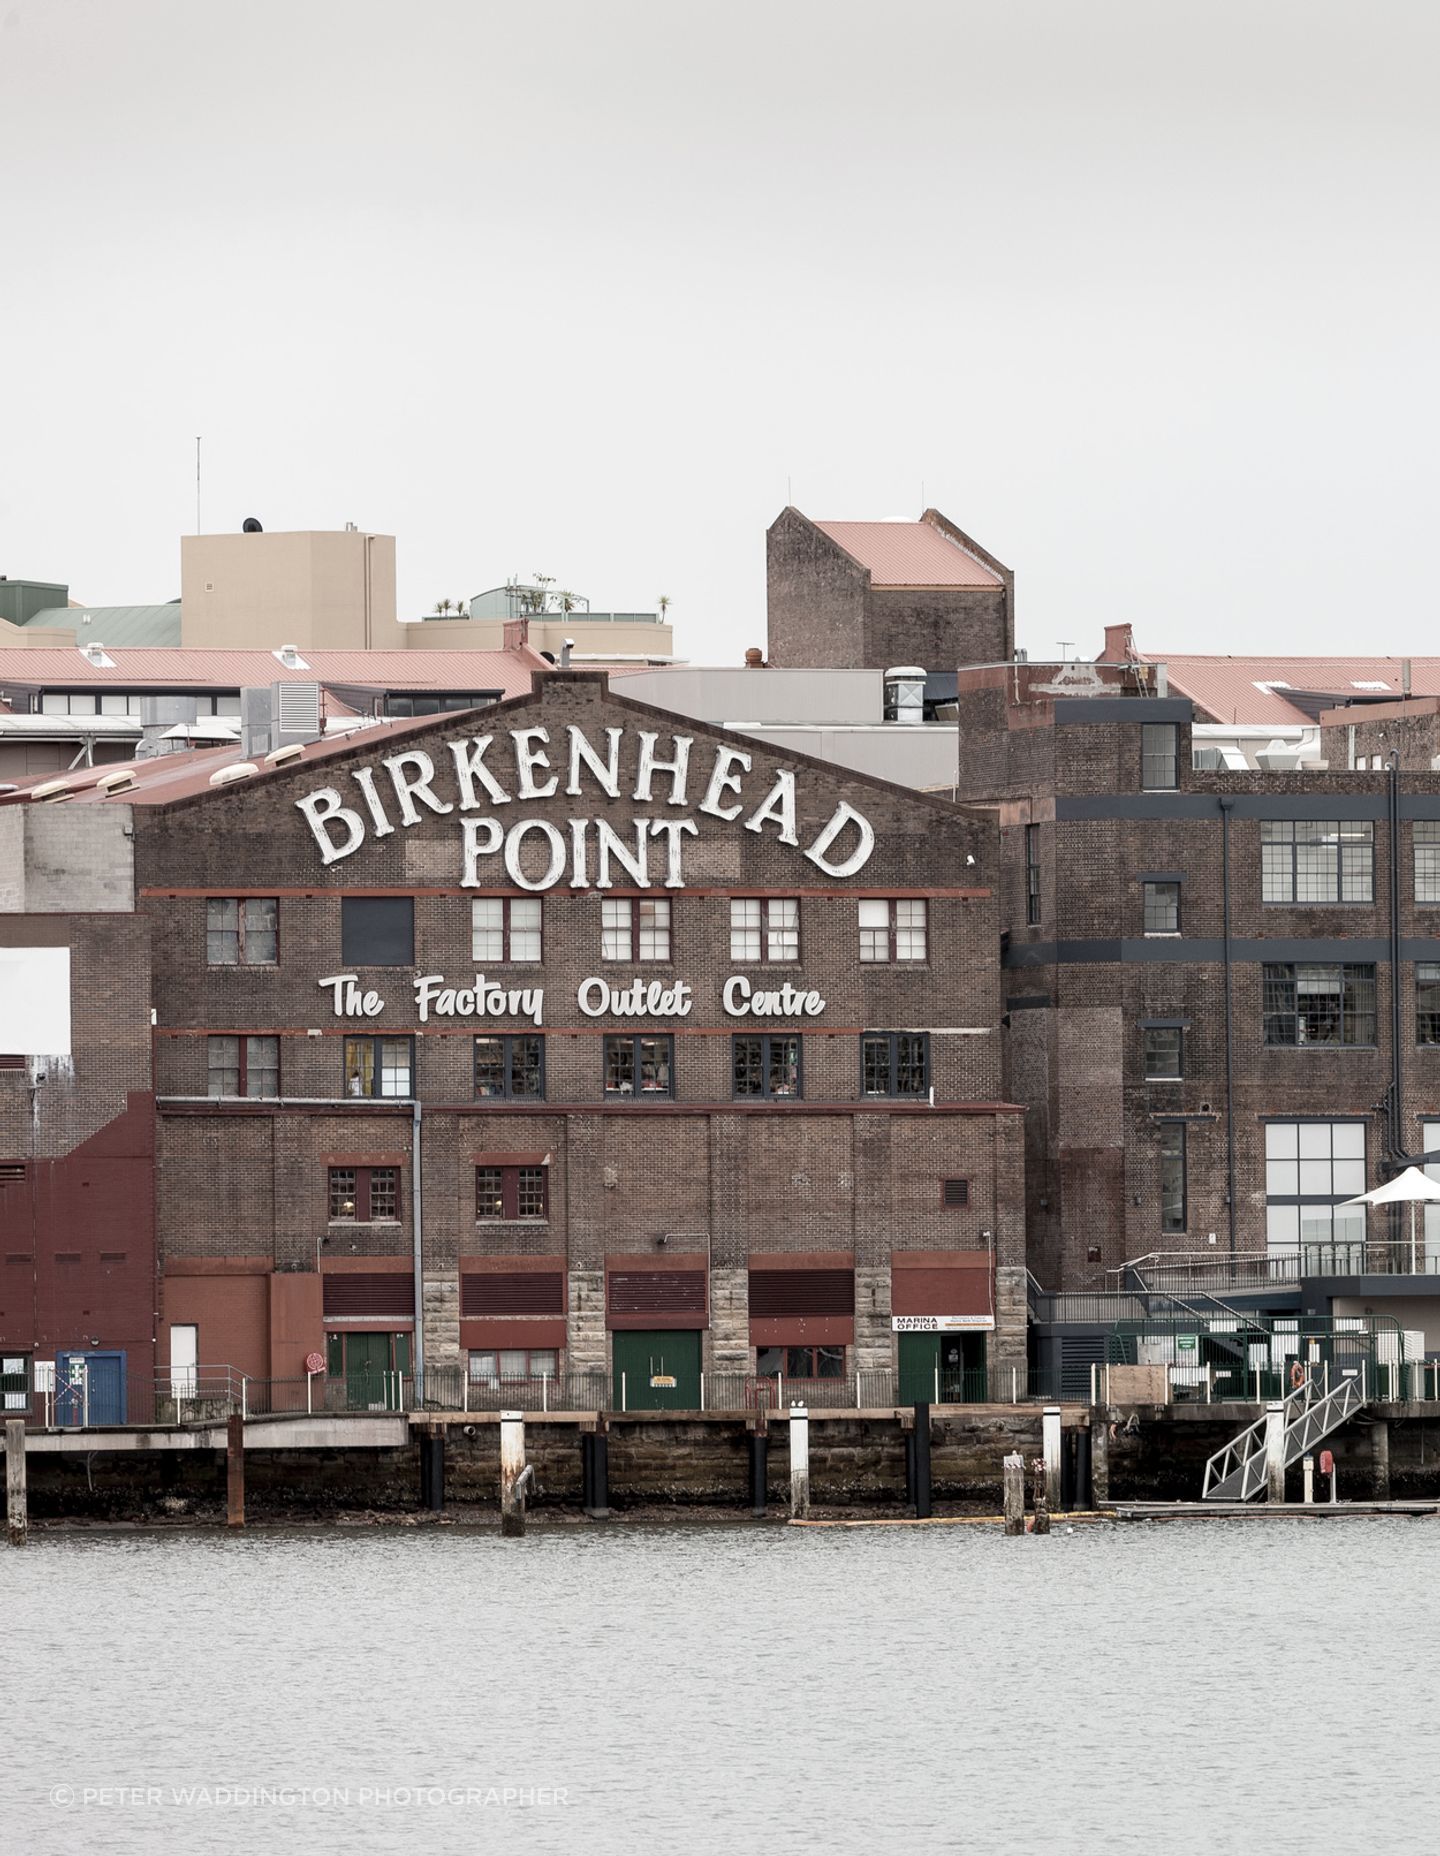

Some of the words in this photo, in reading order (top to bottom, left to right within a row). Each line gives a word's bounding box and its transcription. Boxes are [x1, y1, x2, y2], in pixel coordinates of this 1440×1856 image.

[294, 724, 876, 878] BIRKENHEAD
[459, 815, 699, 891] POINT
[318, 974, 385, 1018] The
[413, 973, 544, 1026] Factory
[577, 976, 693, 1018] Outlet
[722, 975, 826, 1018] Centre
